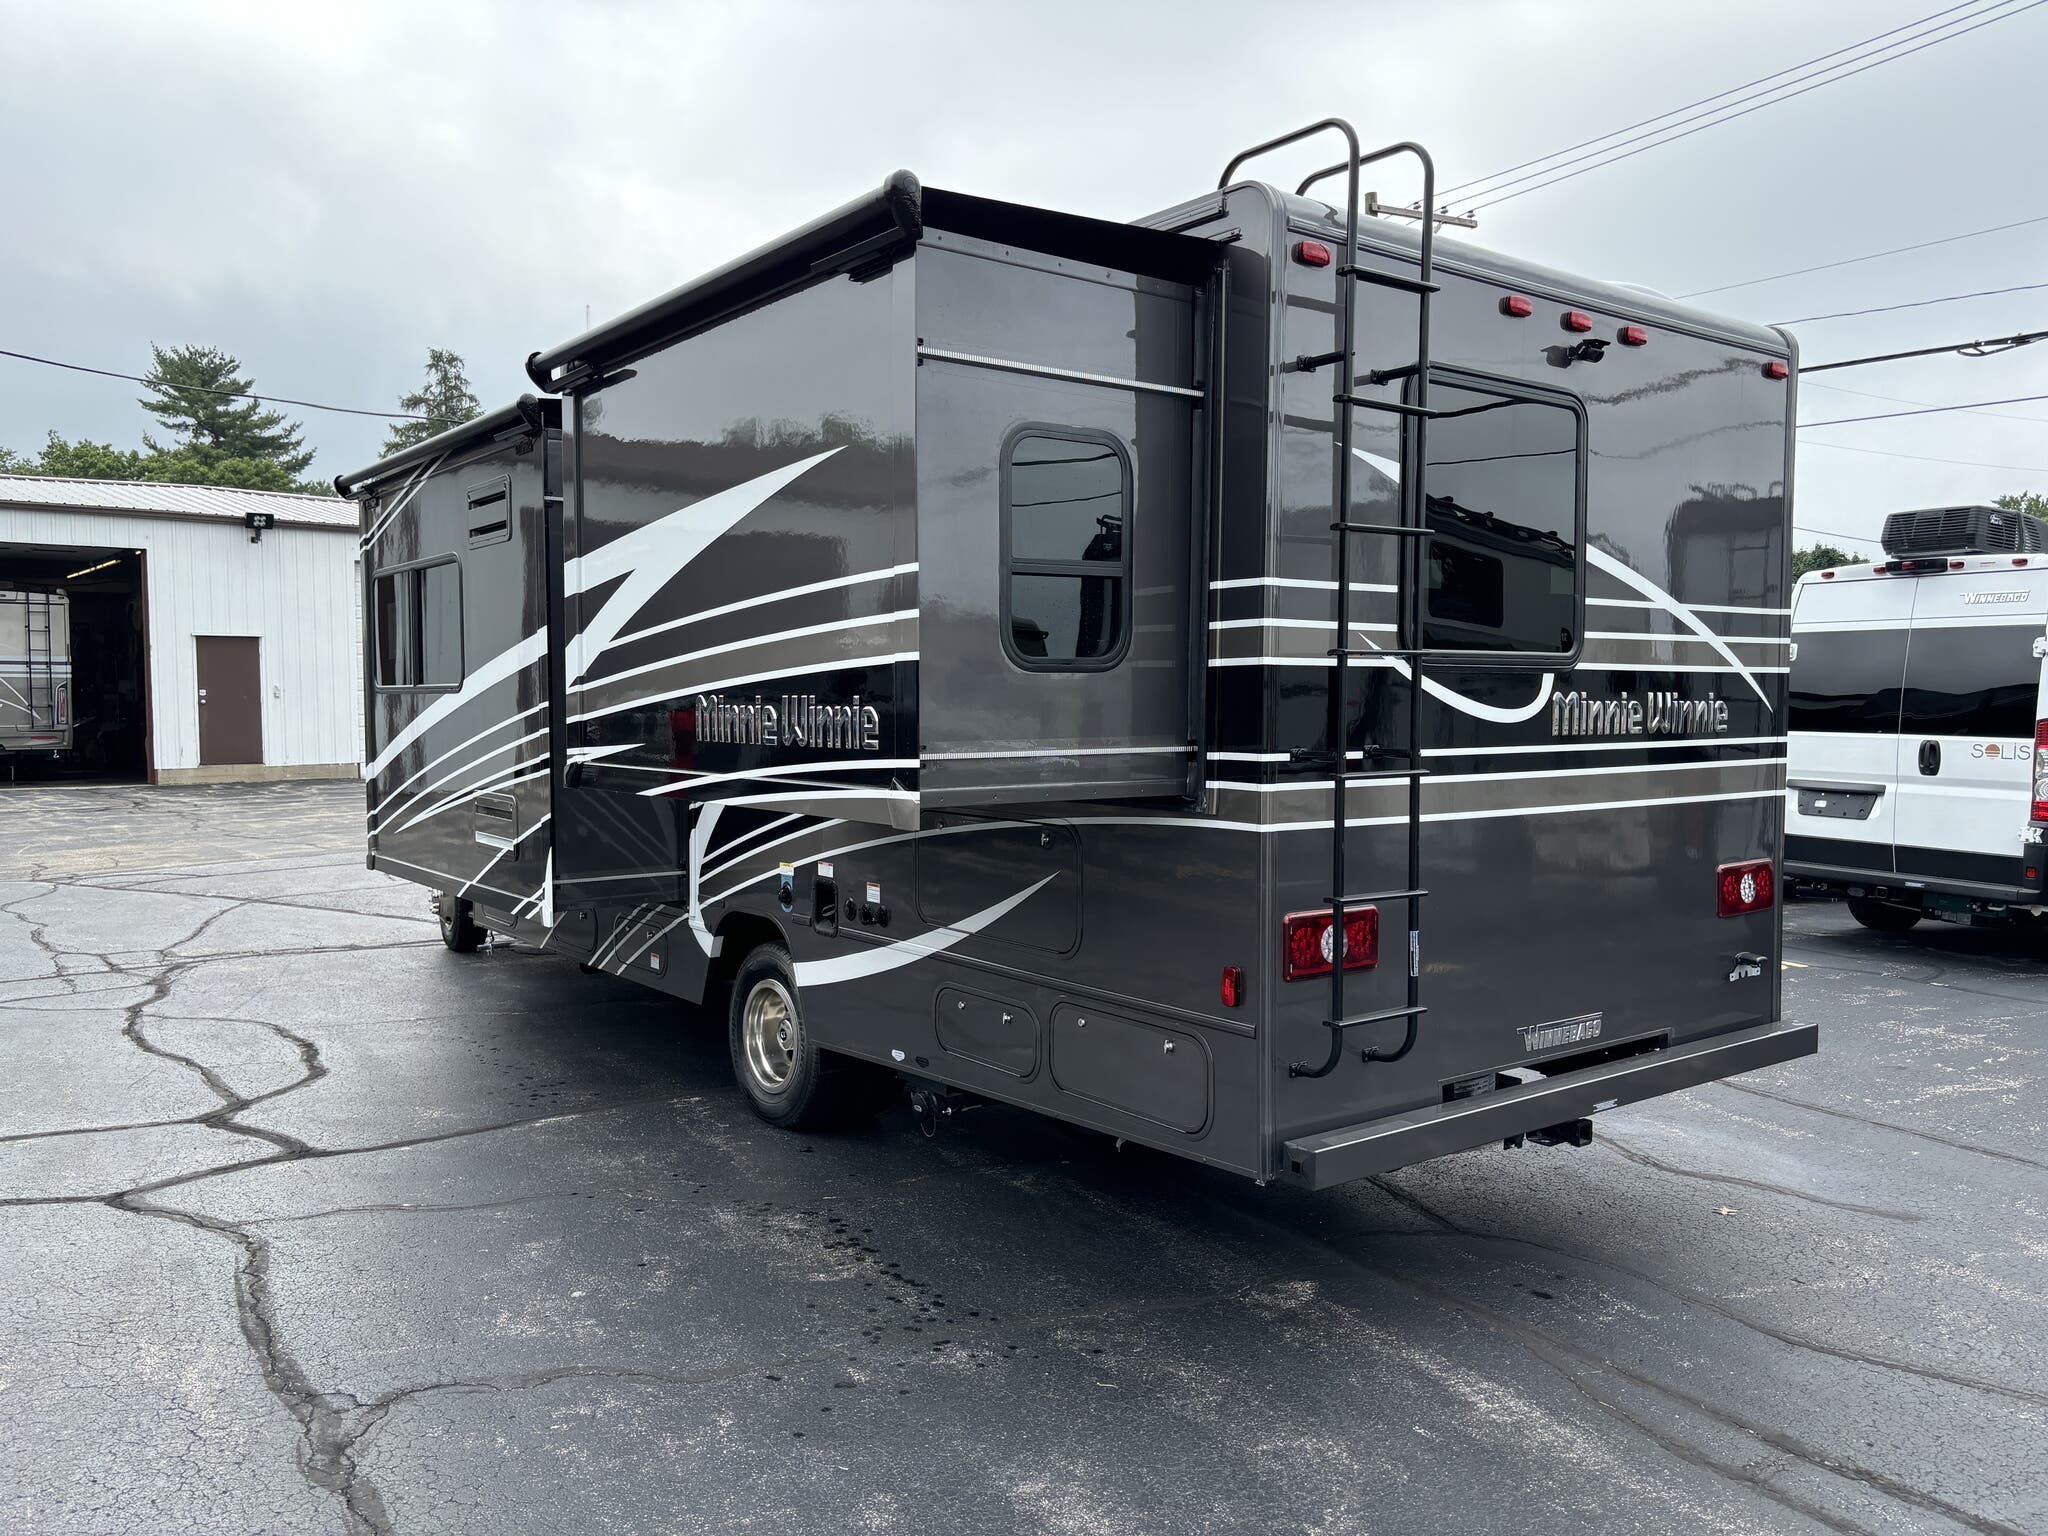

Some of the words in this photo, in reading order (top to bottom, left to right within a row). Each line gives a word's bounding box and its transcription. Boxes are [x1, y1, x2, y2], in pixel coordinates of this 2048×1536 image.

[1960, 589, 2031, 605] WINNEBAGO
[695, 694, 778, 746] Minnie
[781, 695, 880, 751] Winnie
[1551, 691, 1643, 736] Minnie
[1647, 691, 1729, 735] Winnie
[1516, 1011, 1603, 1052] WINNEBAGO
